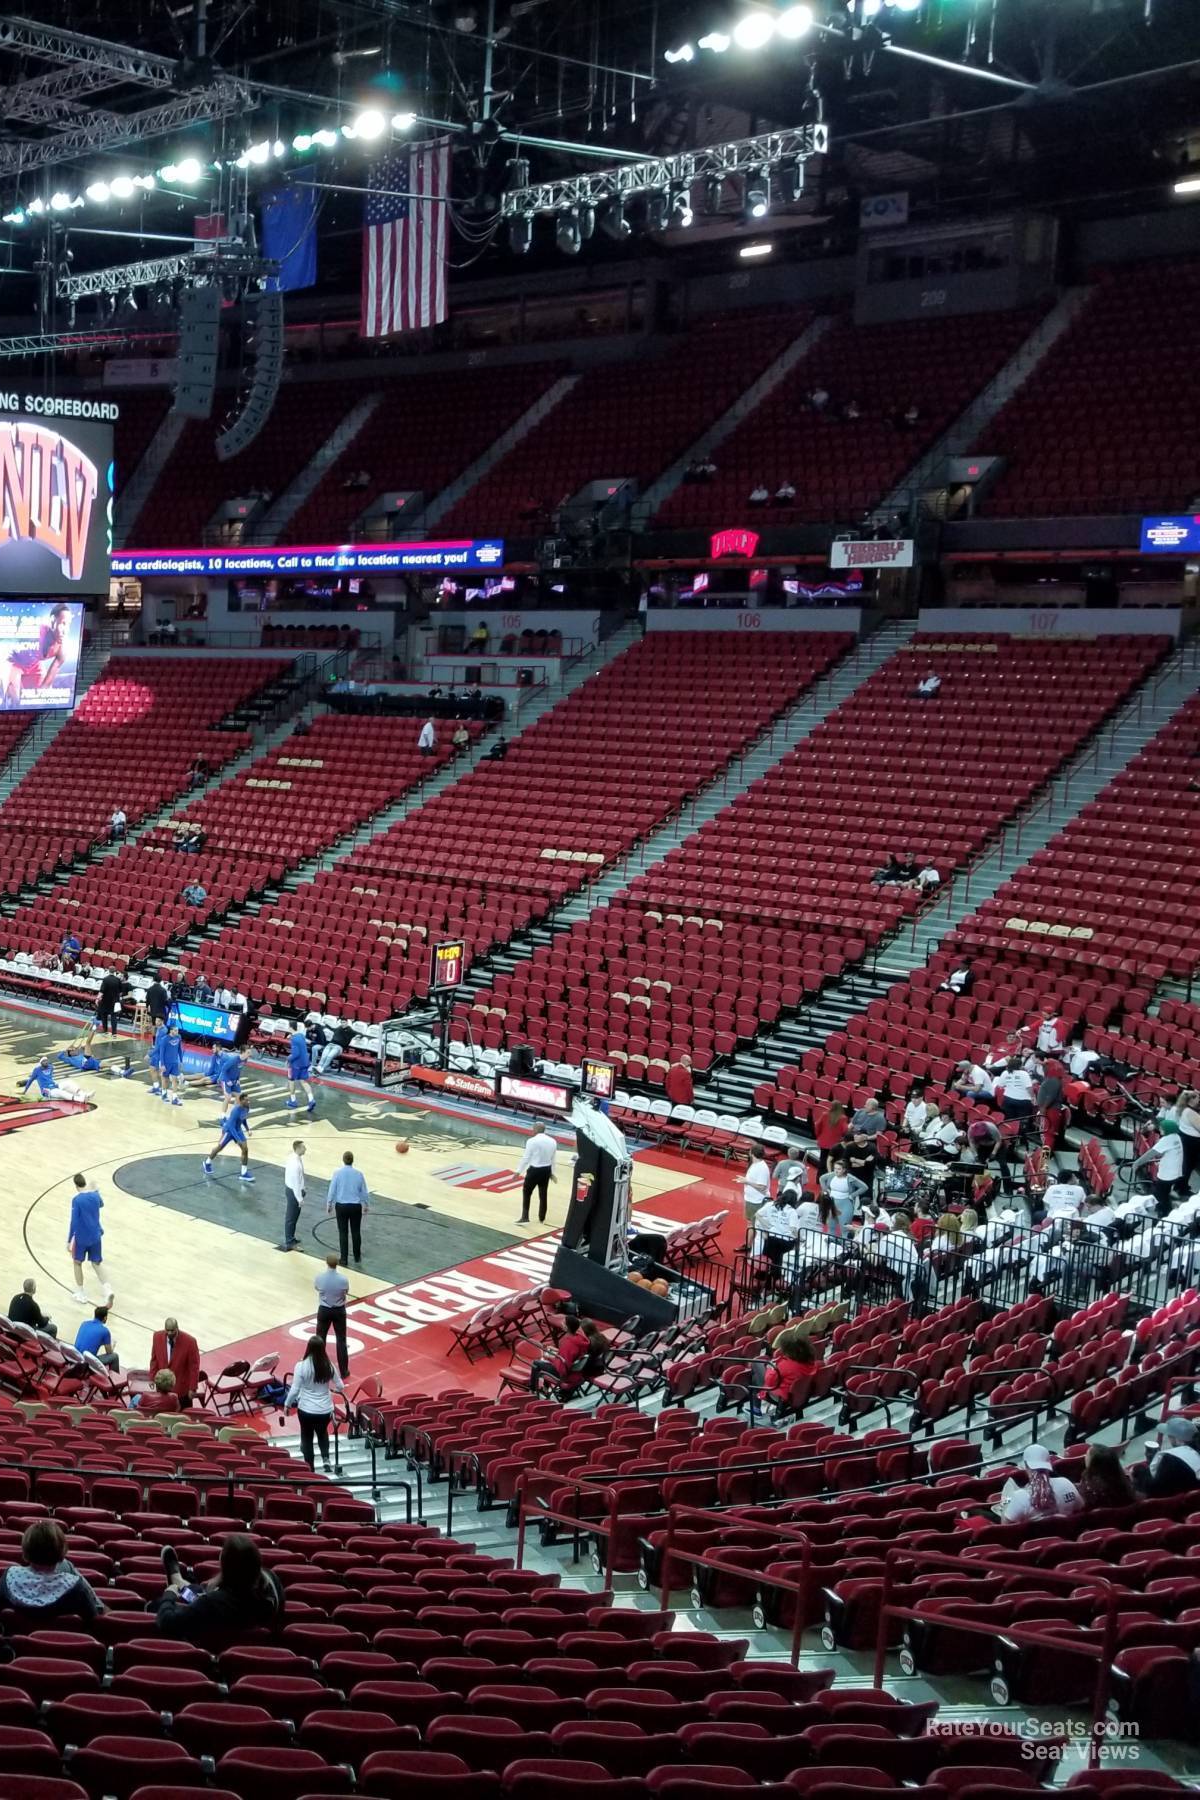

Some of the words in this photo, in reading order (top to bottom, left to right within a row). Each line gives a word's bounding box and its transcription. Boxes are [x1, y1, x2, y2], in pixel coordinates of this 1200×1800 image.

[25, 395, 119, 420] SCOREBOARD
[711, 529, 759, 559] UNLV
[135, 559, 204, 572] cardiologists,
[208, 558, 222, 570] 10
[225, 557, 274, 570] locations,
[277, 556, 298, 568] Call
[301, 557, 312, 567] to
[315, 556, 335, 567] find
[338, 555, 355, 566] the
[358, 554, 398, 566] location
[402, 554, 442, 565] nearest
[444, 552, 467, 566] you!
[502, 614, 521, 628] 105
[737, 613, 761, 629] 106
[1029, 613, 1058, 630] 107
[446, 959, 456, 981] 0
